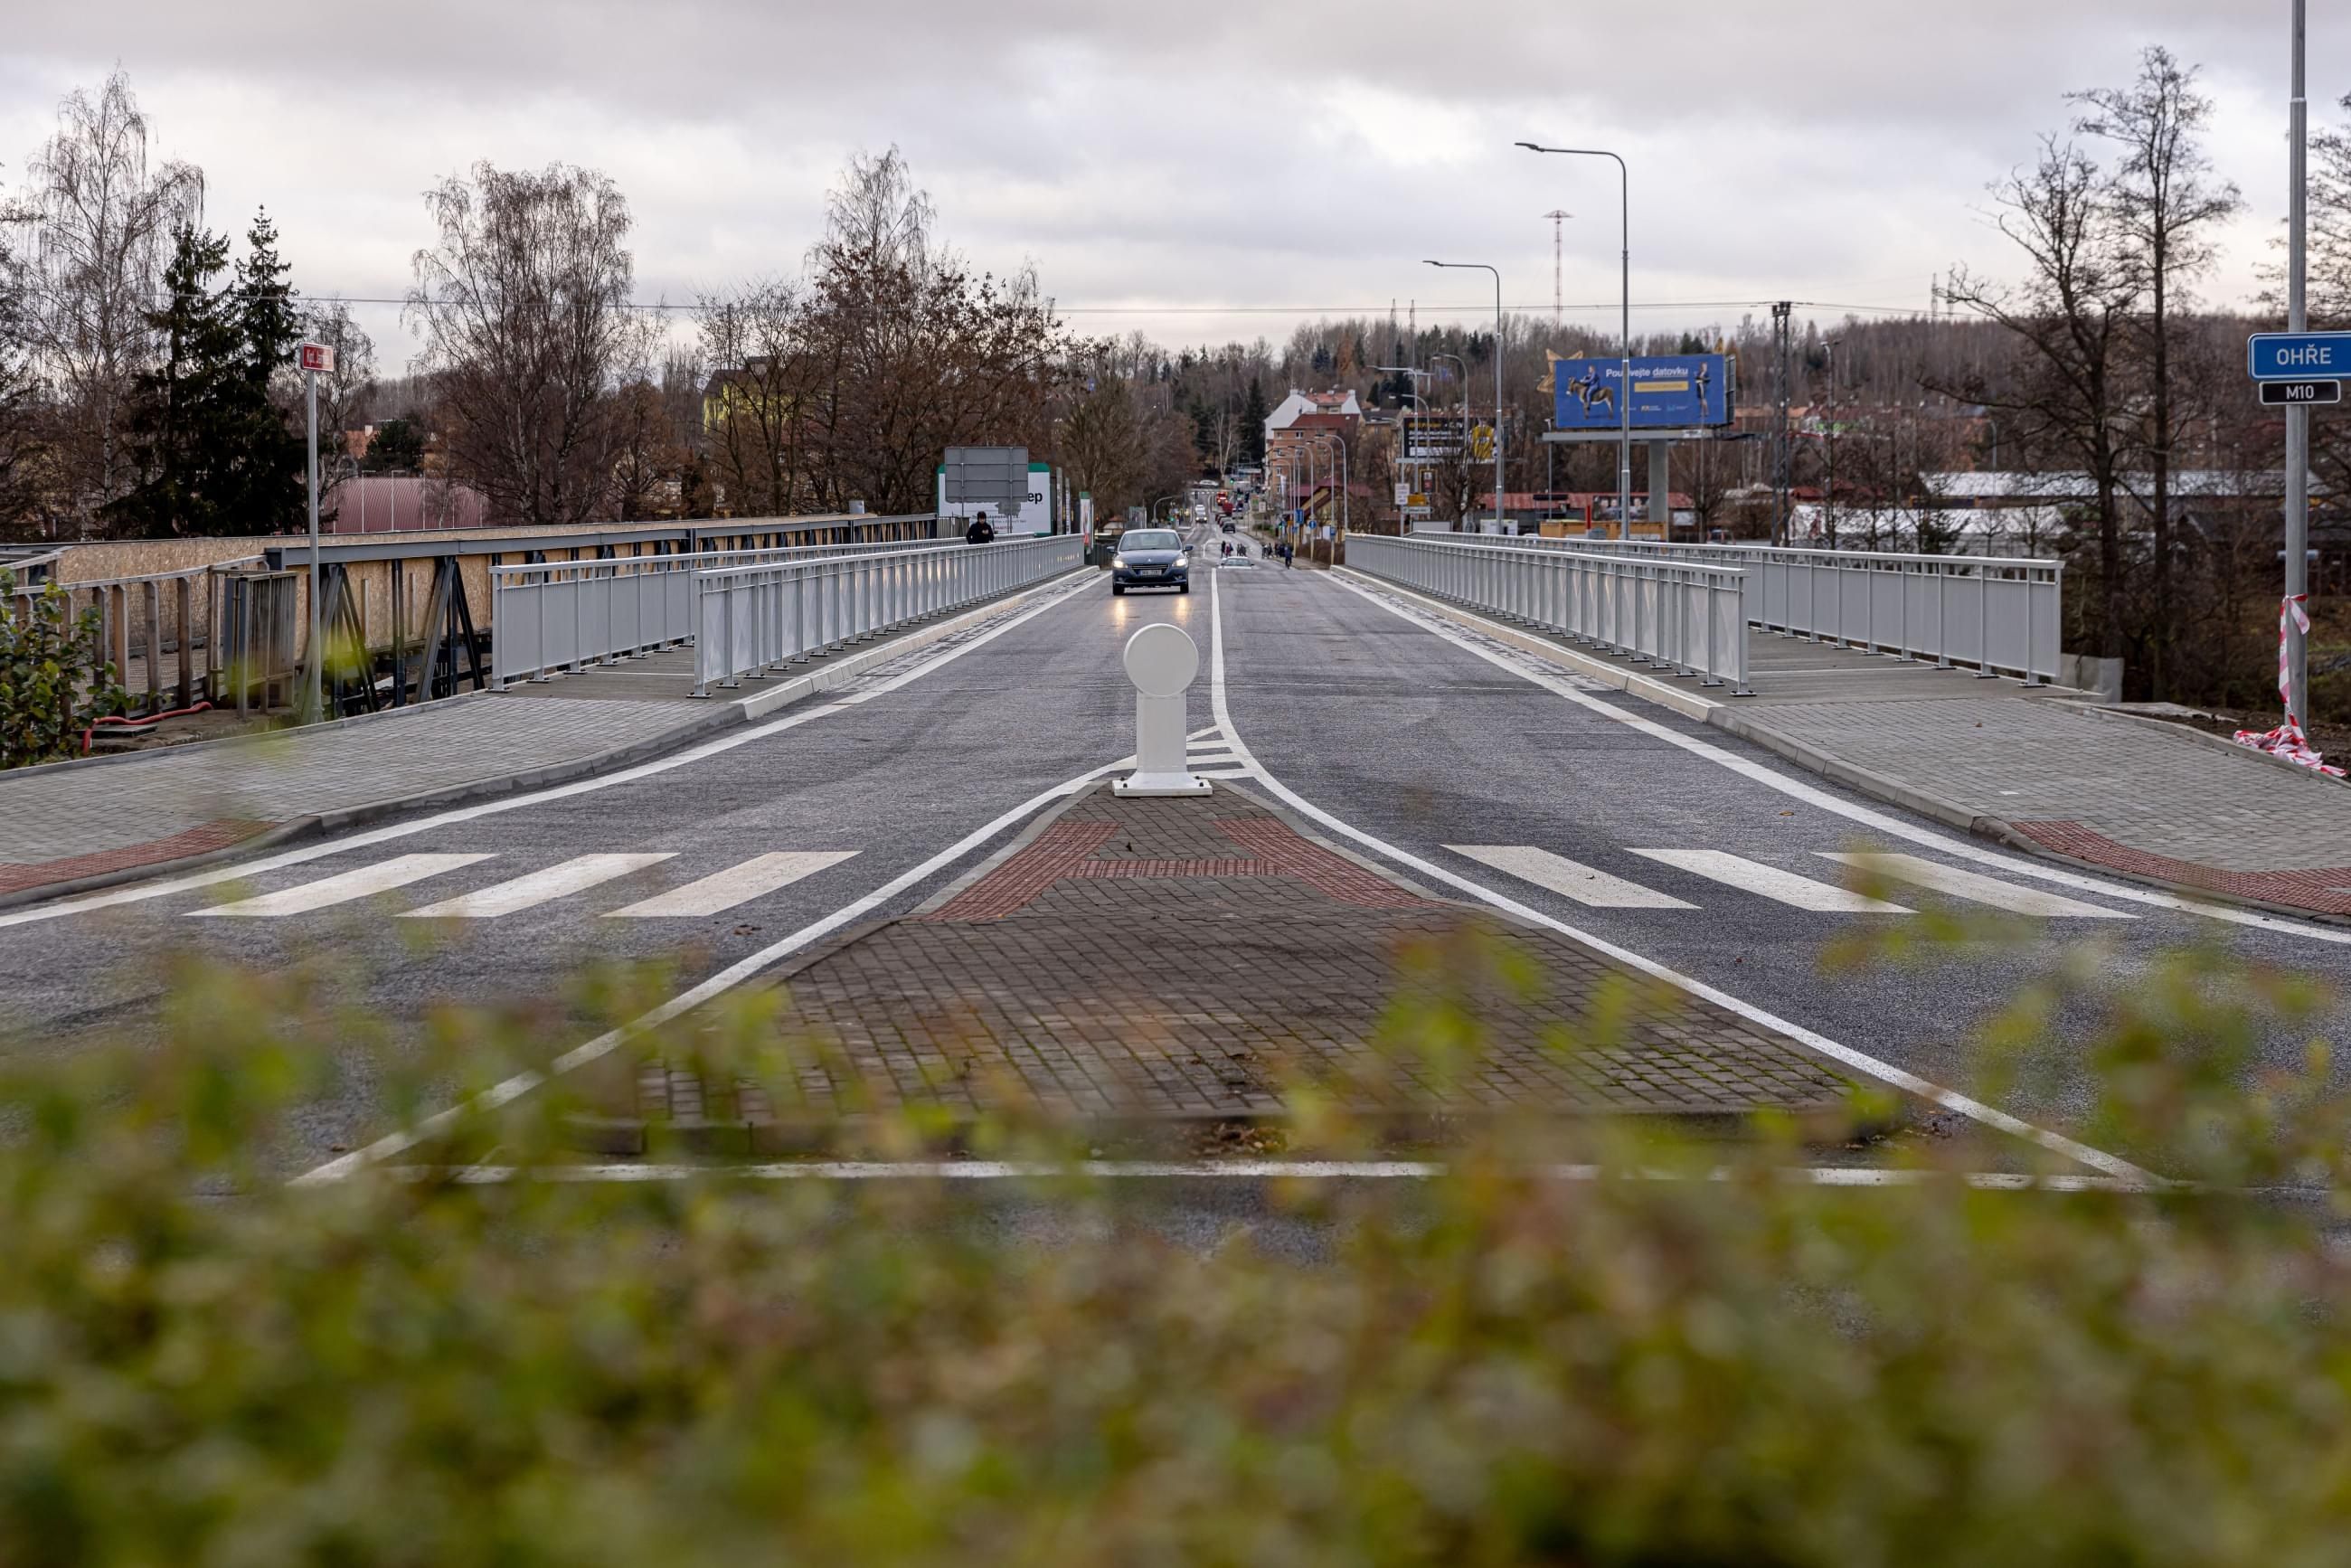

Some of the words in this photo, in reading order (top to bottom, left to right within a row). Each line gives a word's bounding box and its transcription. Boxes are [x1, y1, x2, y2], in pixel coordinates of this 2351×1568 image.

[2276, 344, 2332, 365] OHŘE
[1605, 367, 1651, 378] Pouvejte
[1652, 366, 1689, 377] datovku
[2286, 385, 2315, 400] M10
[1027, 492, 1043, 505] ep
